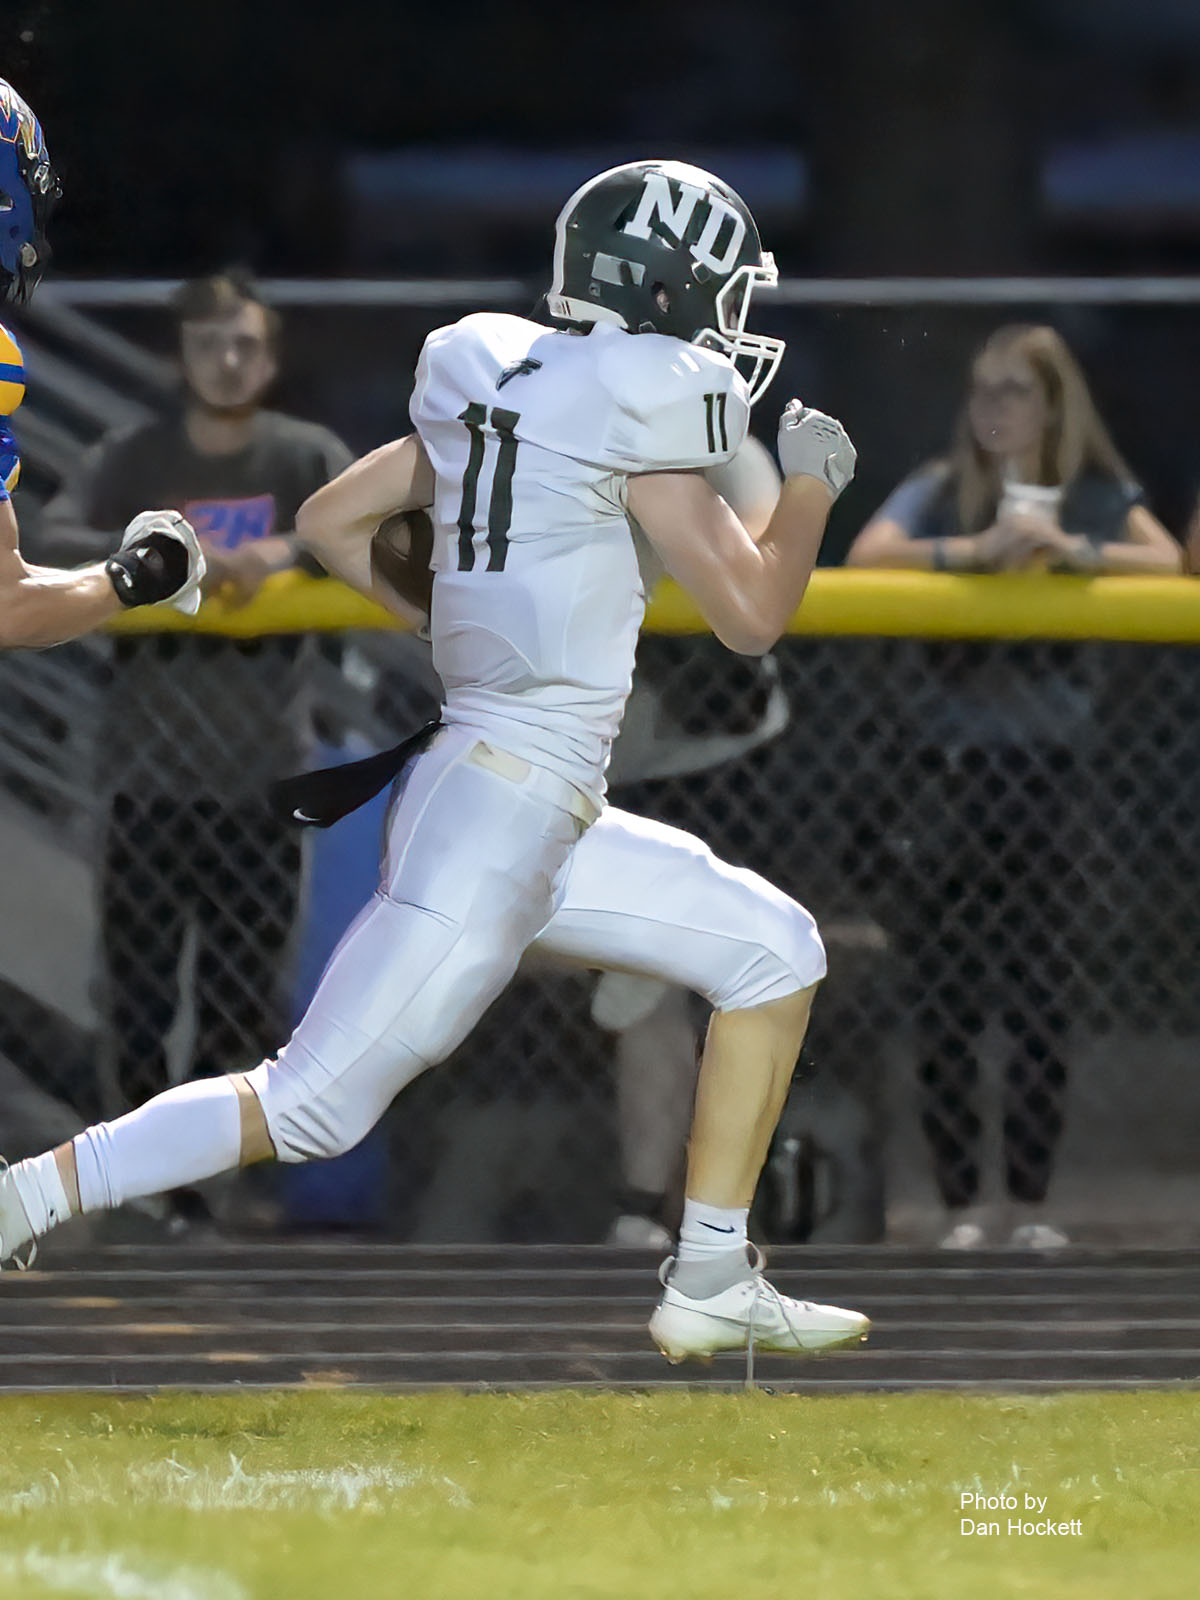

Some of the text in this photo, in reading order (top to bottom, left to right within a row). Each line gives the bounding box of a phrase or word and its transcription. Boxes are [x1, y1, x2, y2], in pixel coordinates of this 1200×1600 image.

[623, 172, 747, 275] ND
[703, 391, 729, 454] 11
[456, 401, 521, 573] 11
